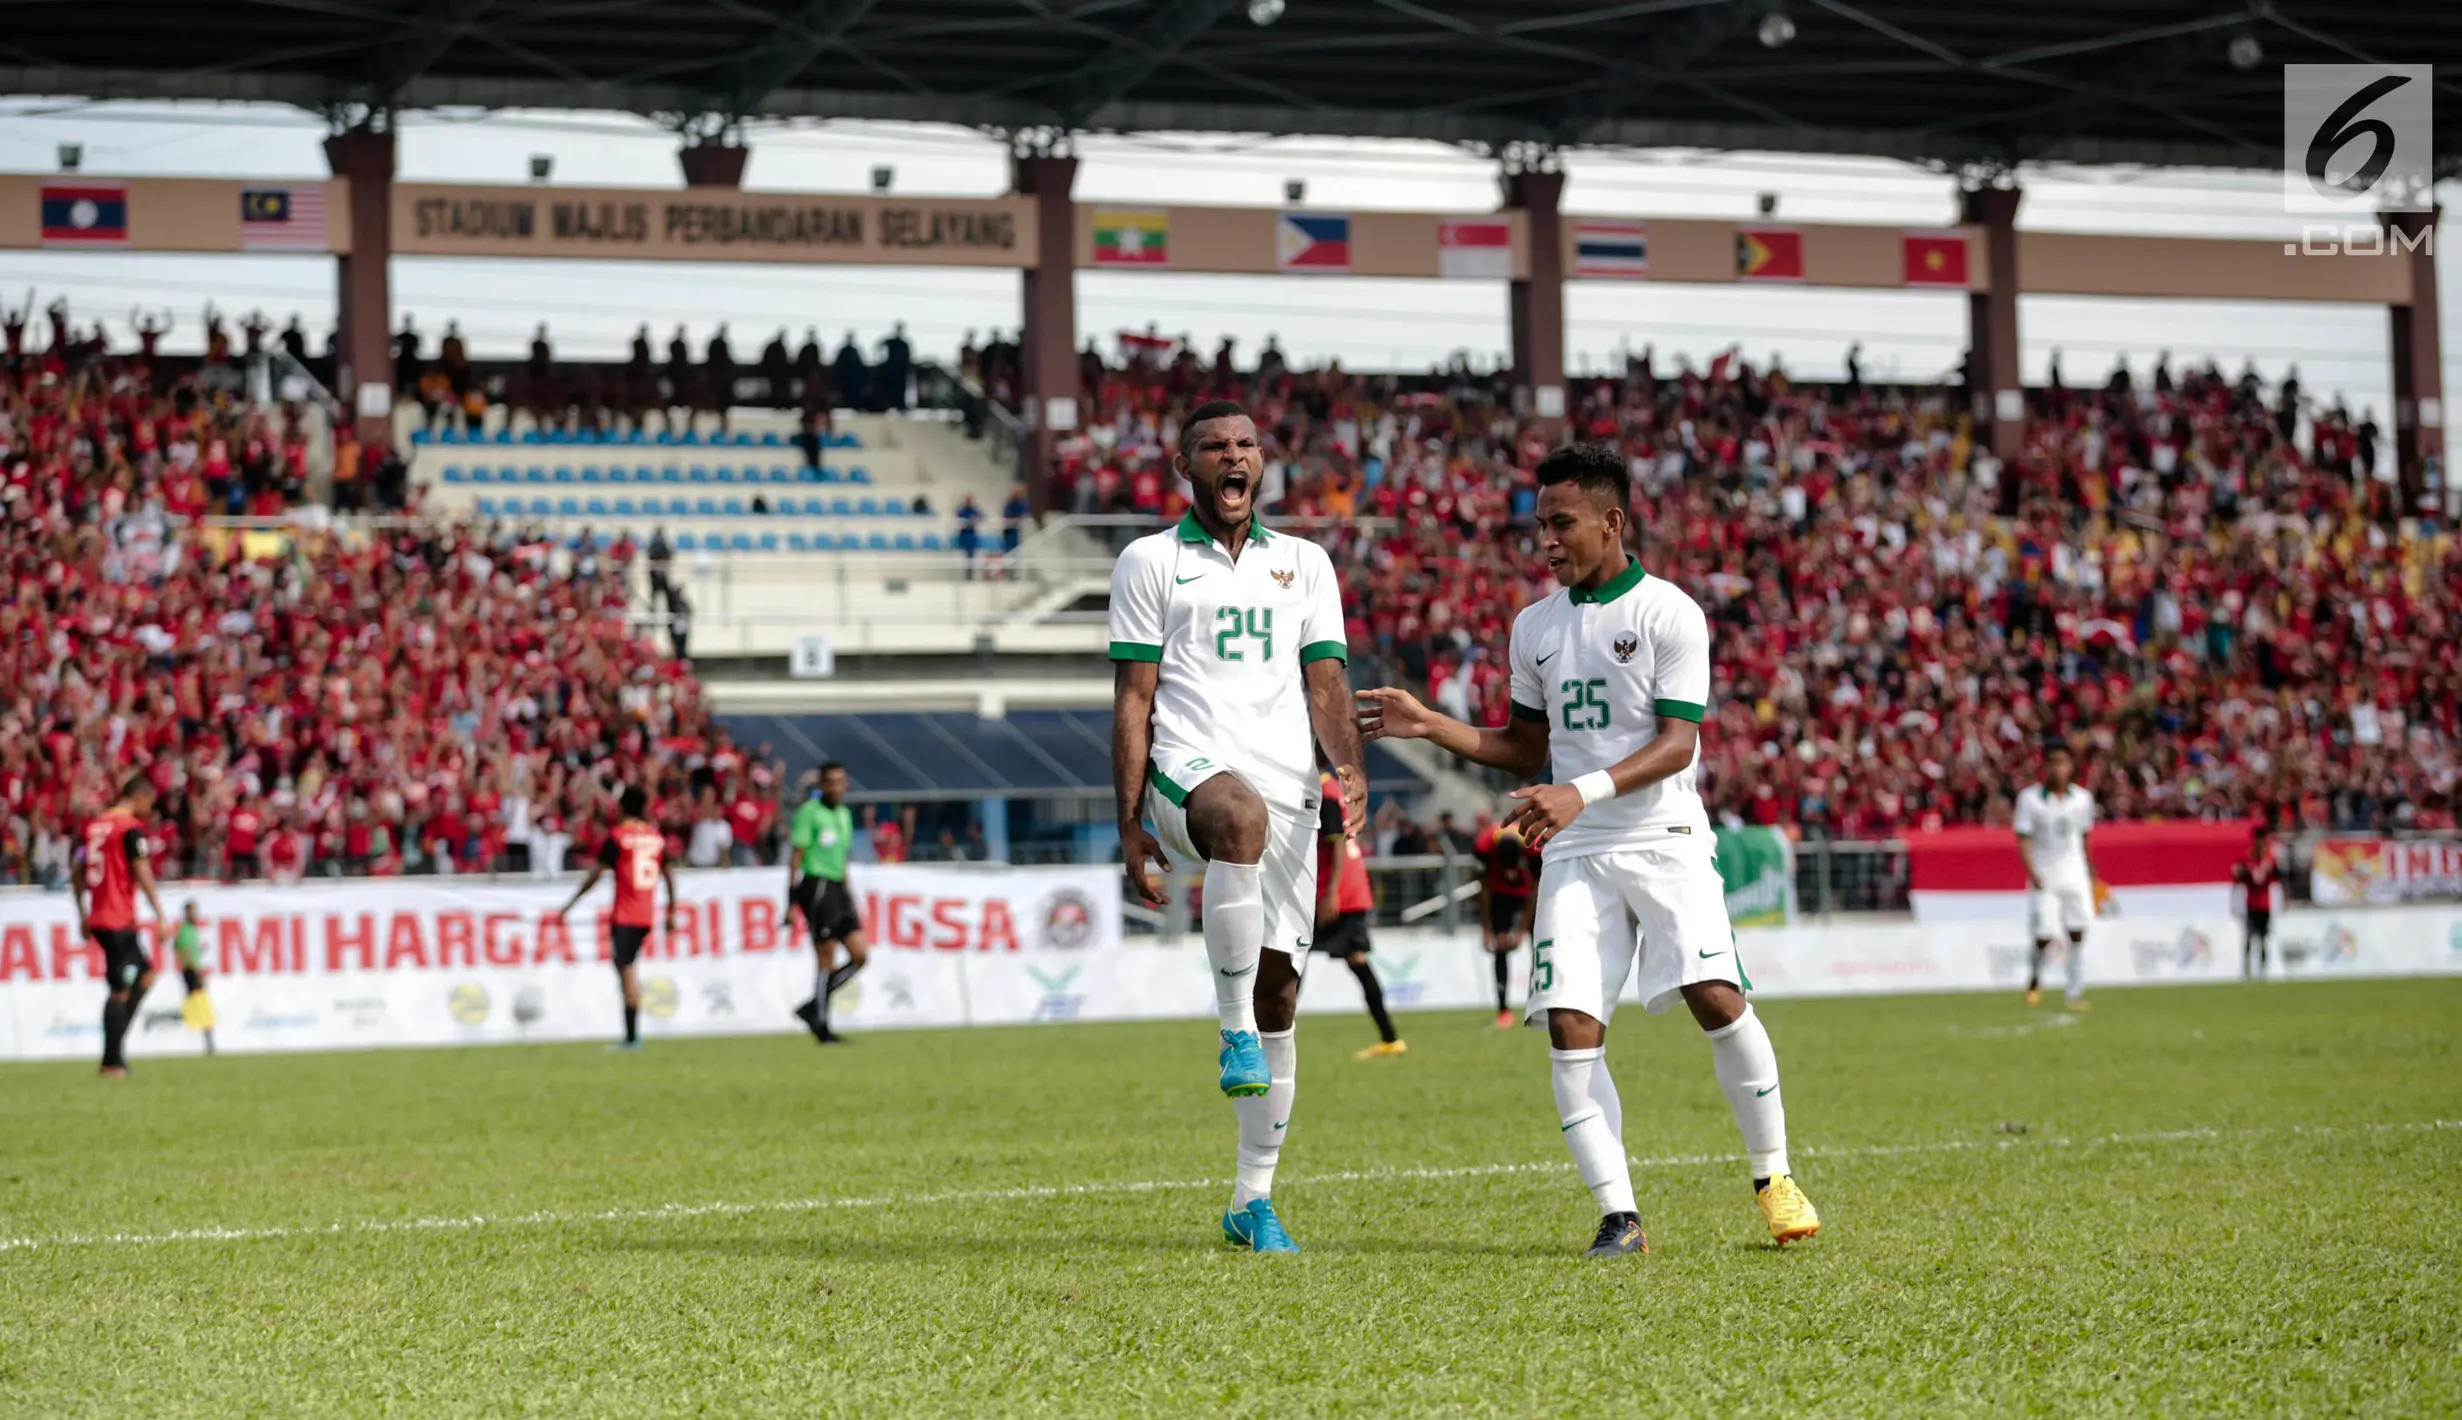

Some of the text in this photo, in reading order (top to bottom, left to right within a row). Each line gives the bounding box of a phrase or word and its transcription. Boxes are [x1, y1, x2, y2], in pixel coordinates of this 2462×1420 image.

[414, 199, 1016, 251] STADIUM MAJLIS PERBANDARAN SELAYANG
[1215, 605, 1273, 663] 24
[1561, 678, 1611, 731] 25
[324, 909, 577, 974] HARGA
